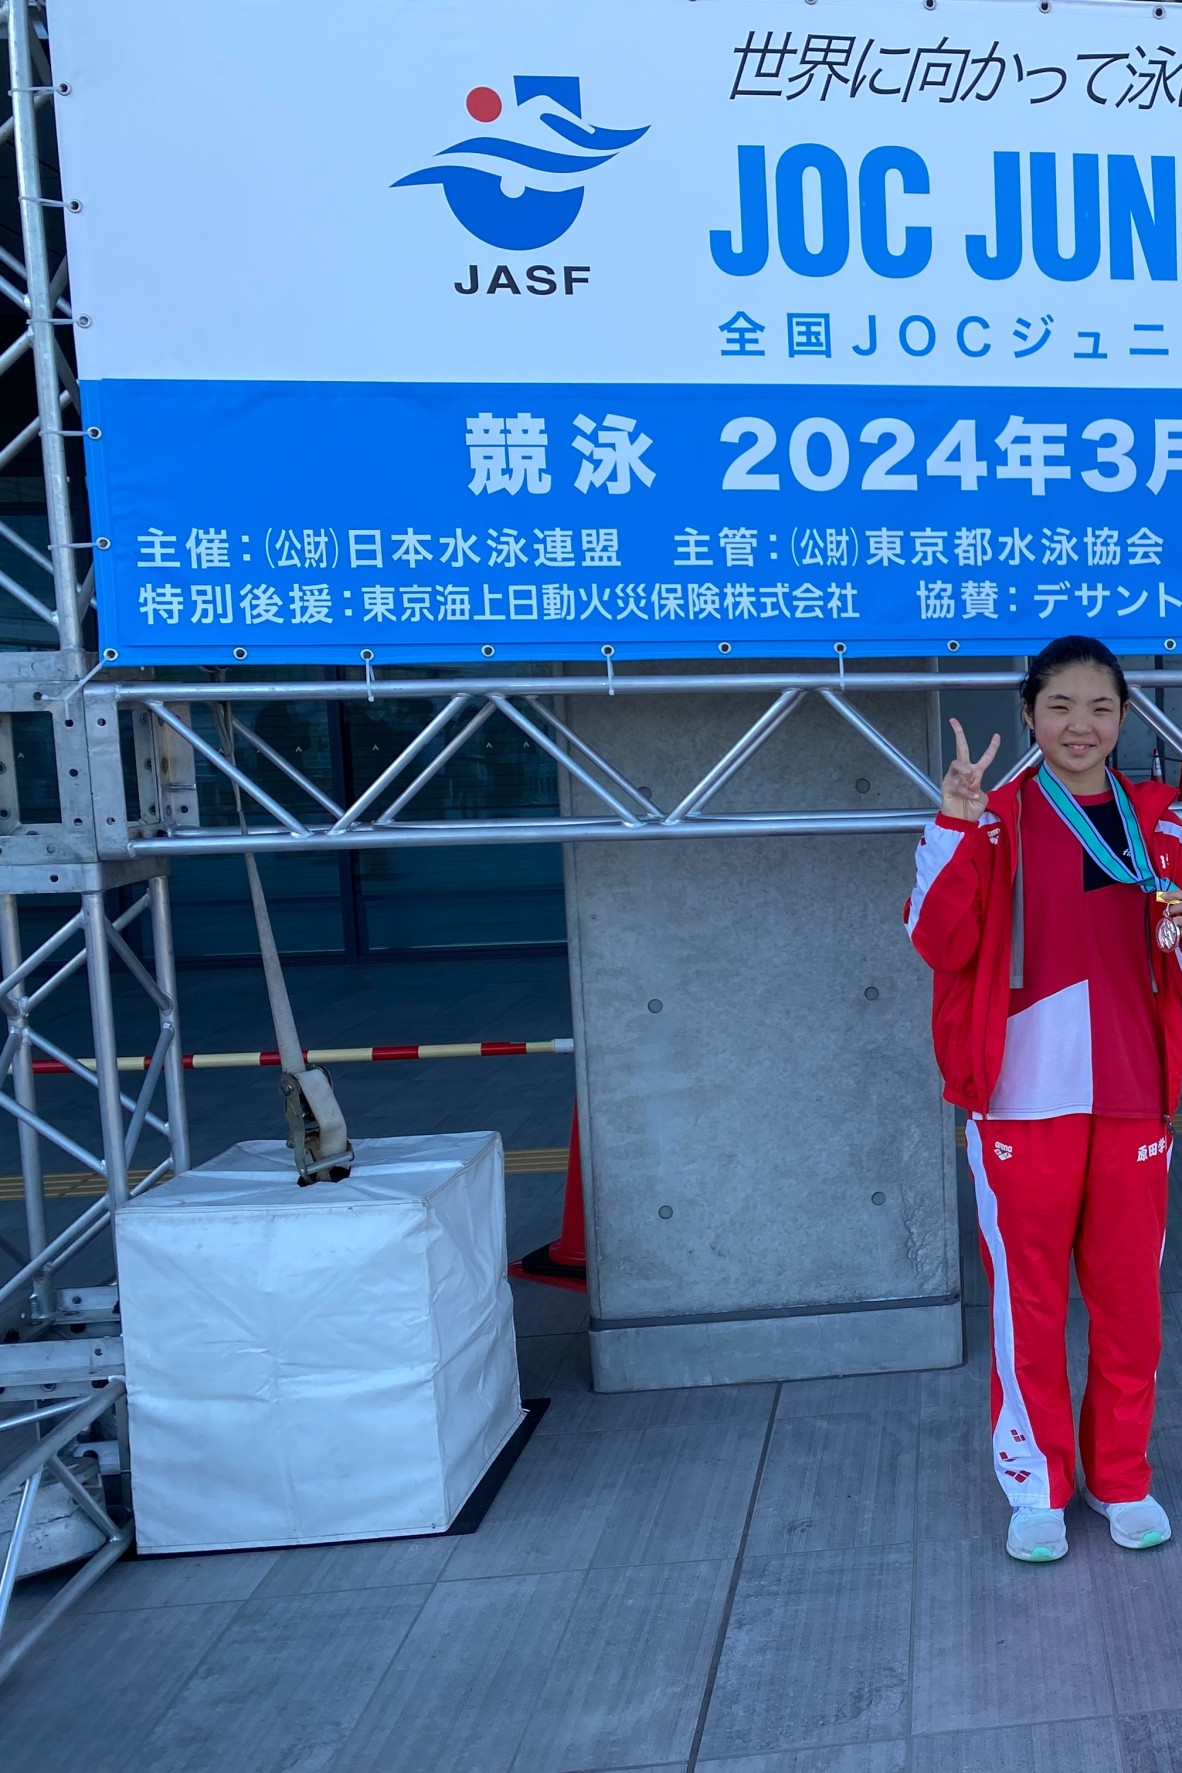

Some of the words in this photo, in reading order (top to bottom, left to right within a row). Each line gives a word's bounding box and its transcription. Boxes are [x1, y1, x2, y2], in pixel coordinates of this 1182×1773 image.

[709, 143, 933, 280] JOC
[454, 265, 591, 295] JASF
[465, 413, 656, 496] 競泳
